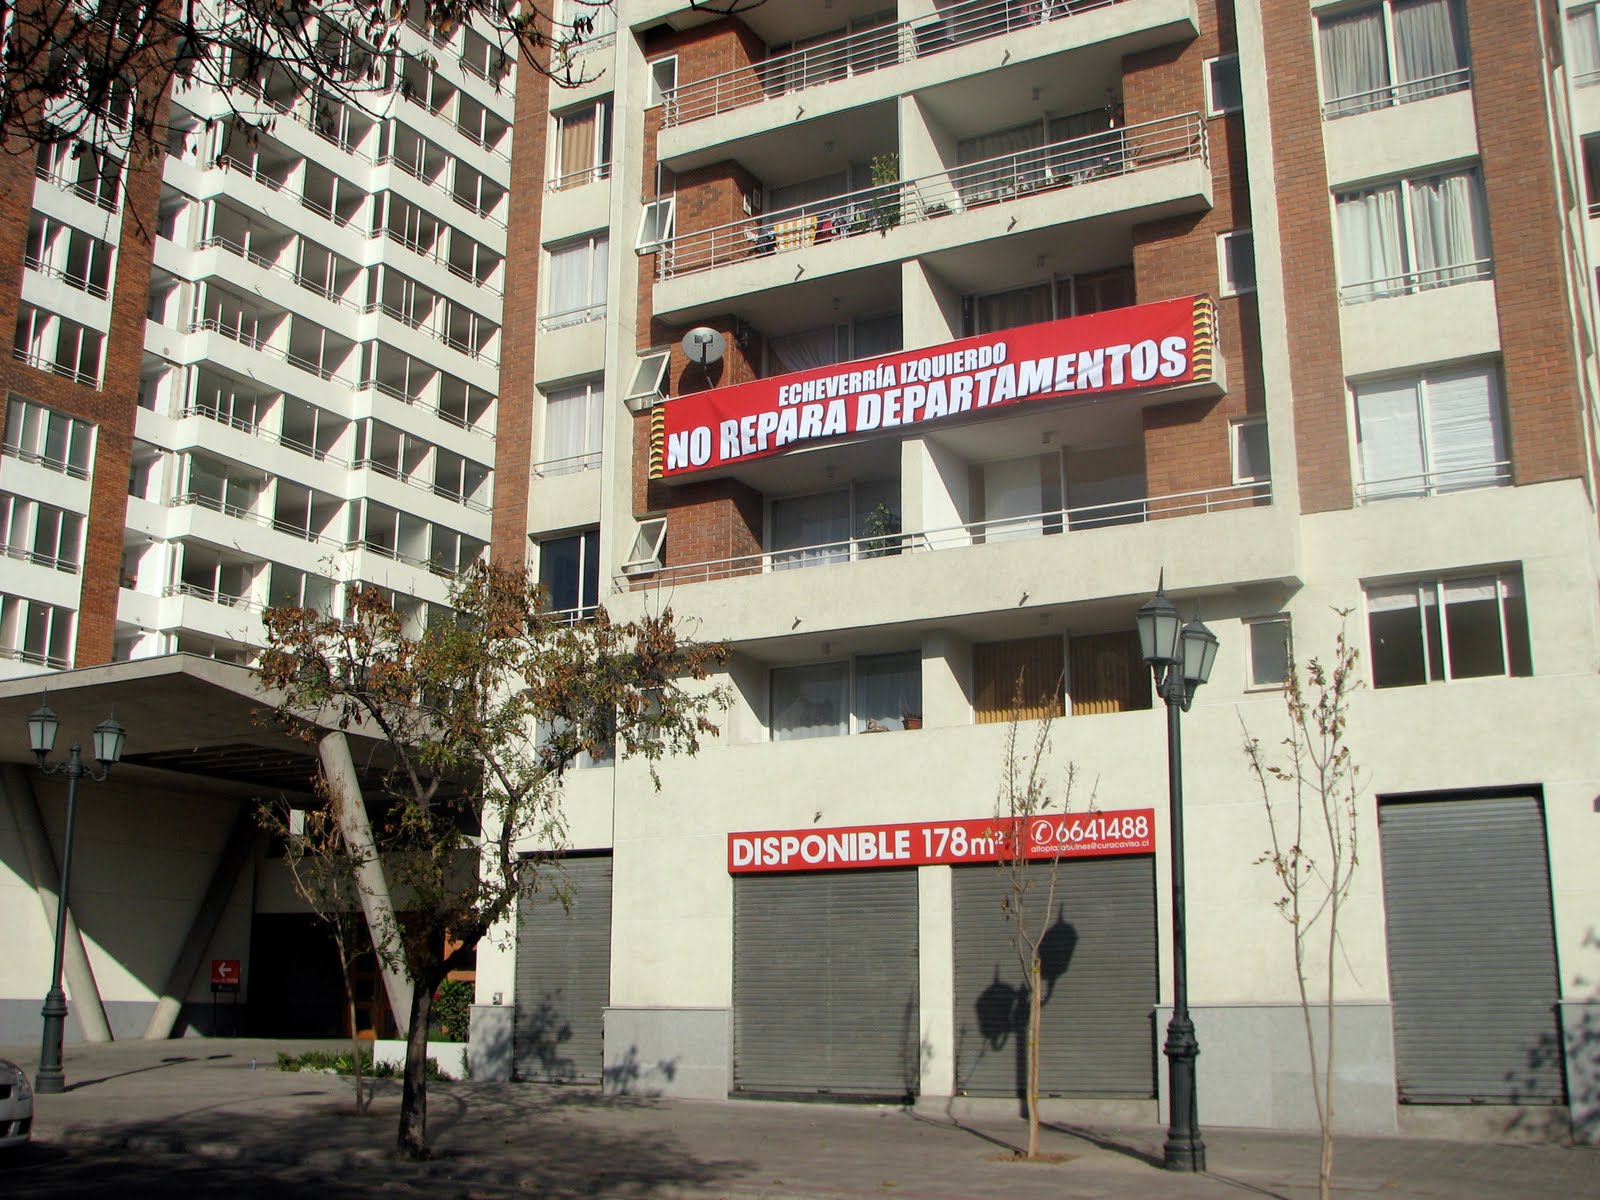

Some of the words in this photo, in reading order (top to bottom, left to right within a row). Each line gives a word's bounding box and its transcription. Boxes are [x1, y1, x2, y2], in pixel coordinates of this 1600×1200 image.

[778, 364, 897, 407] ECHEVERRÍA
[900, 342, 1007, 385] IZQUIERDO
[667, 426, 712, 470] NO
[719, 399, 847, 460] REPARA
[855, 336, 1187, 431] DEPARTAMENTOS
[733, 829, 911, 866] DISPONIBLE
[1056, 815, 1149, 843] 6641488
